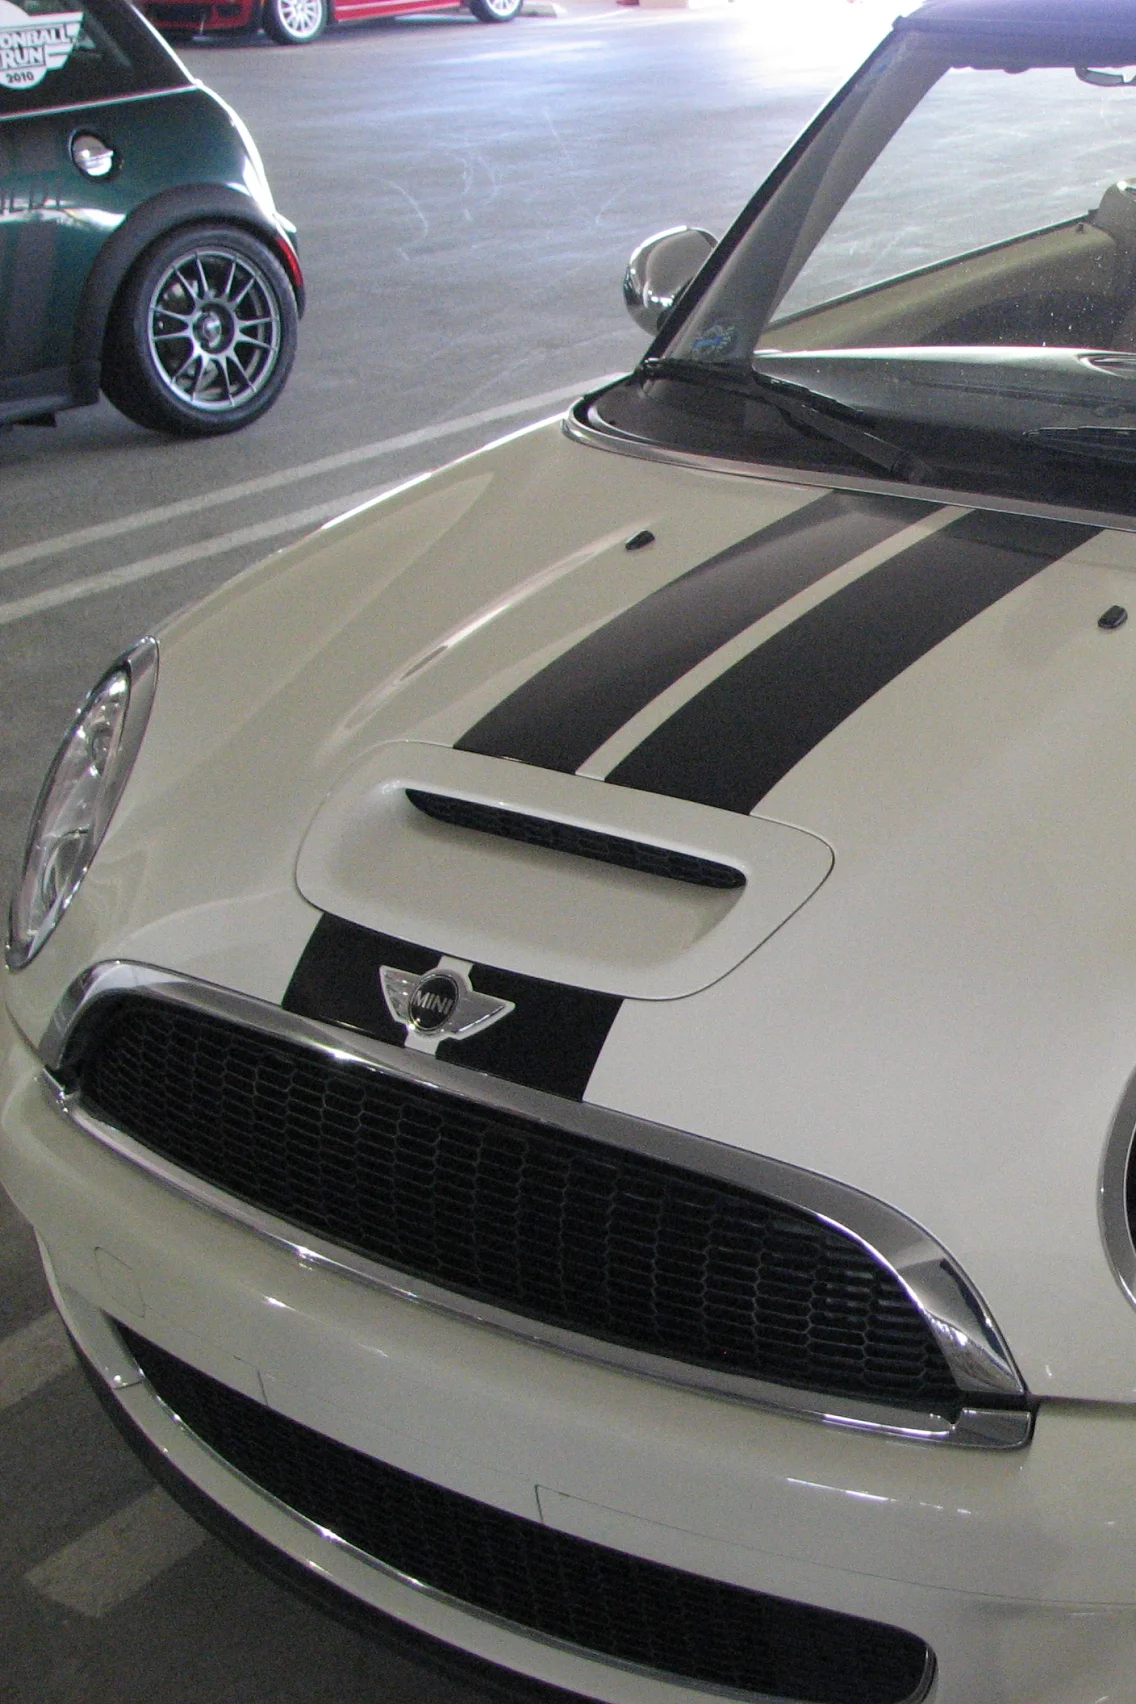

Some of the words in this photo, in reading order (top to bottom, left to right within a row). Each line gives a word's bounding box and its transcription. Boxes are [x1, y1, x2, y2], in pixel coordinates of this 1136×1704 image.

[1, 45, 44, 69] RUN
[6, 71, 35, 83] 2010
[413, 989, 453, 1016] MINI
